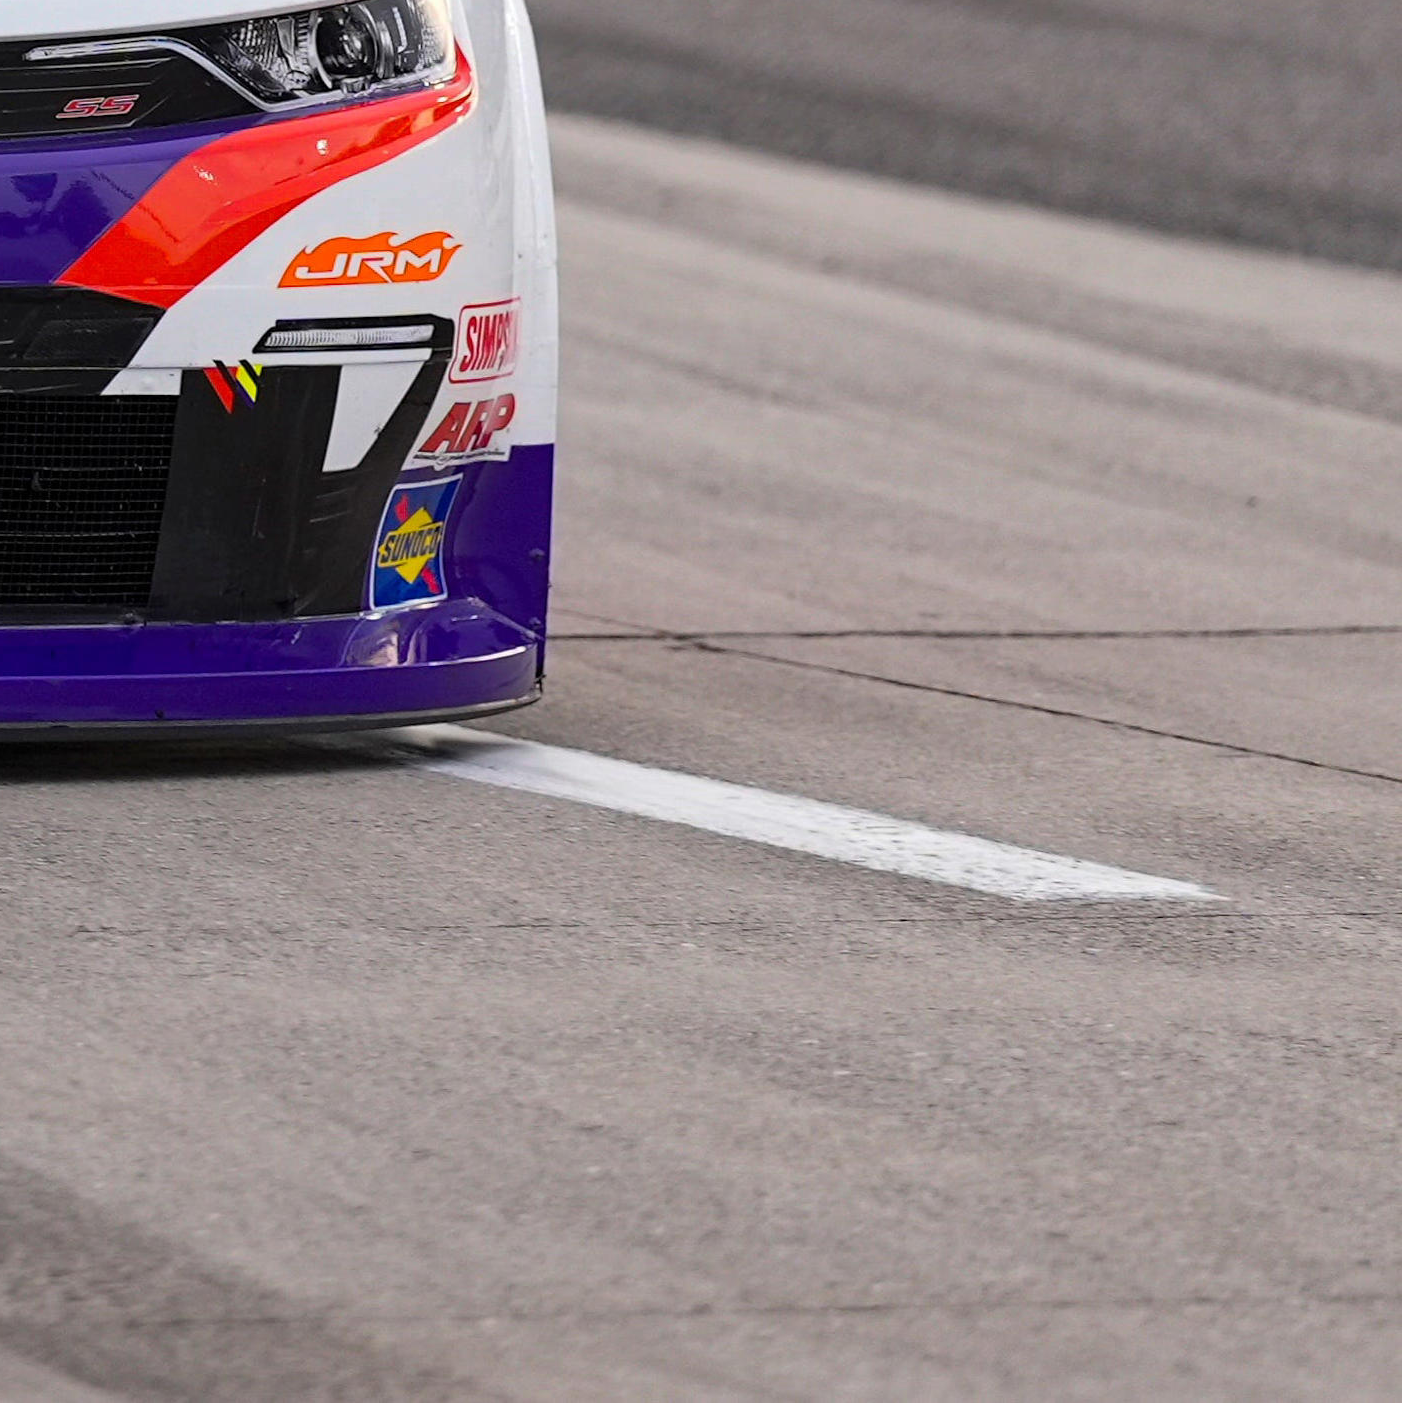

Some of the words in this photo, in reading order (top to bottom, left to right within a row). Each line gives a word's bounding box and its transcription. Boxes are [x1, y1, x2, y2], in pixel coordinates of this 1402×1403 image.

[55, 94, 140, 119] SS
[296, 248, 441, 283] JRM
[416, 393, 515, 453] ARP
[380, 526, 441, 562] SUNOCO
